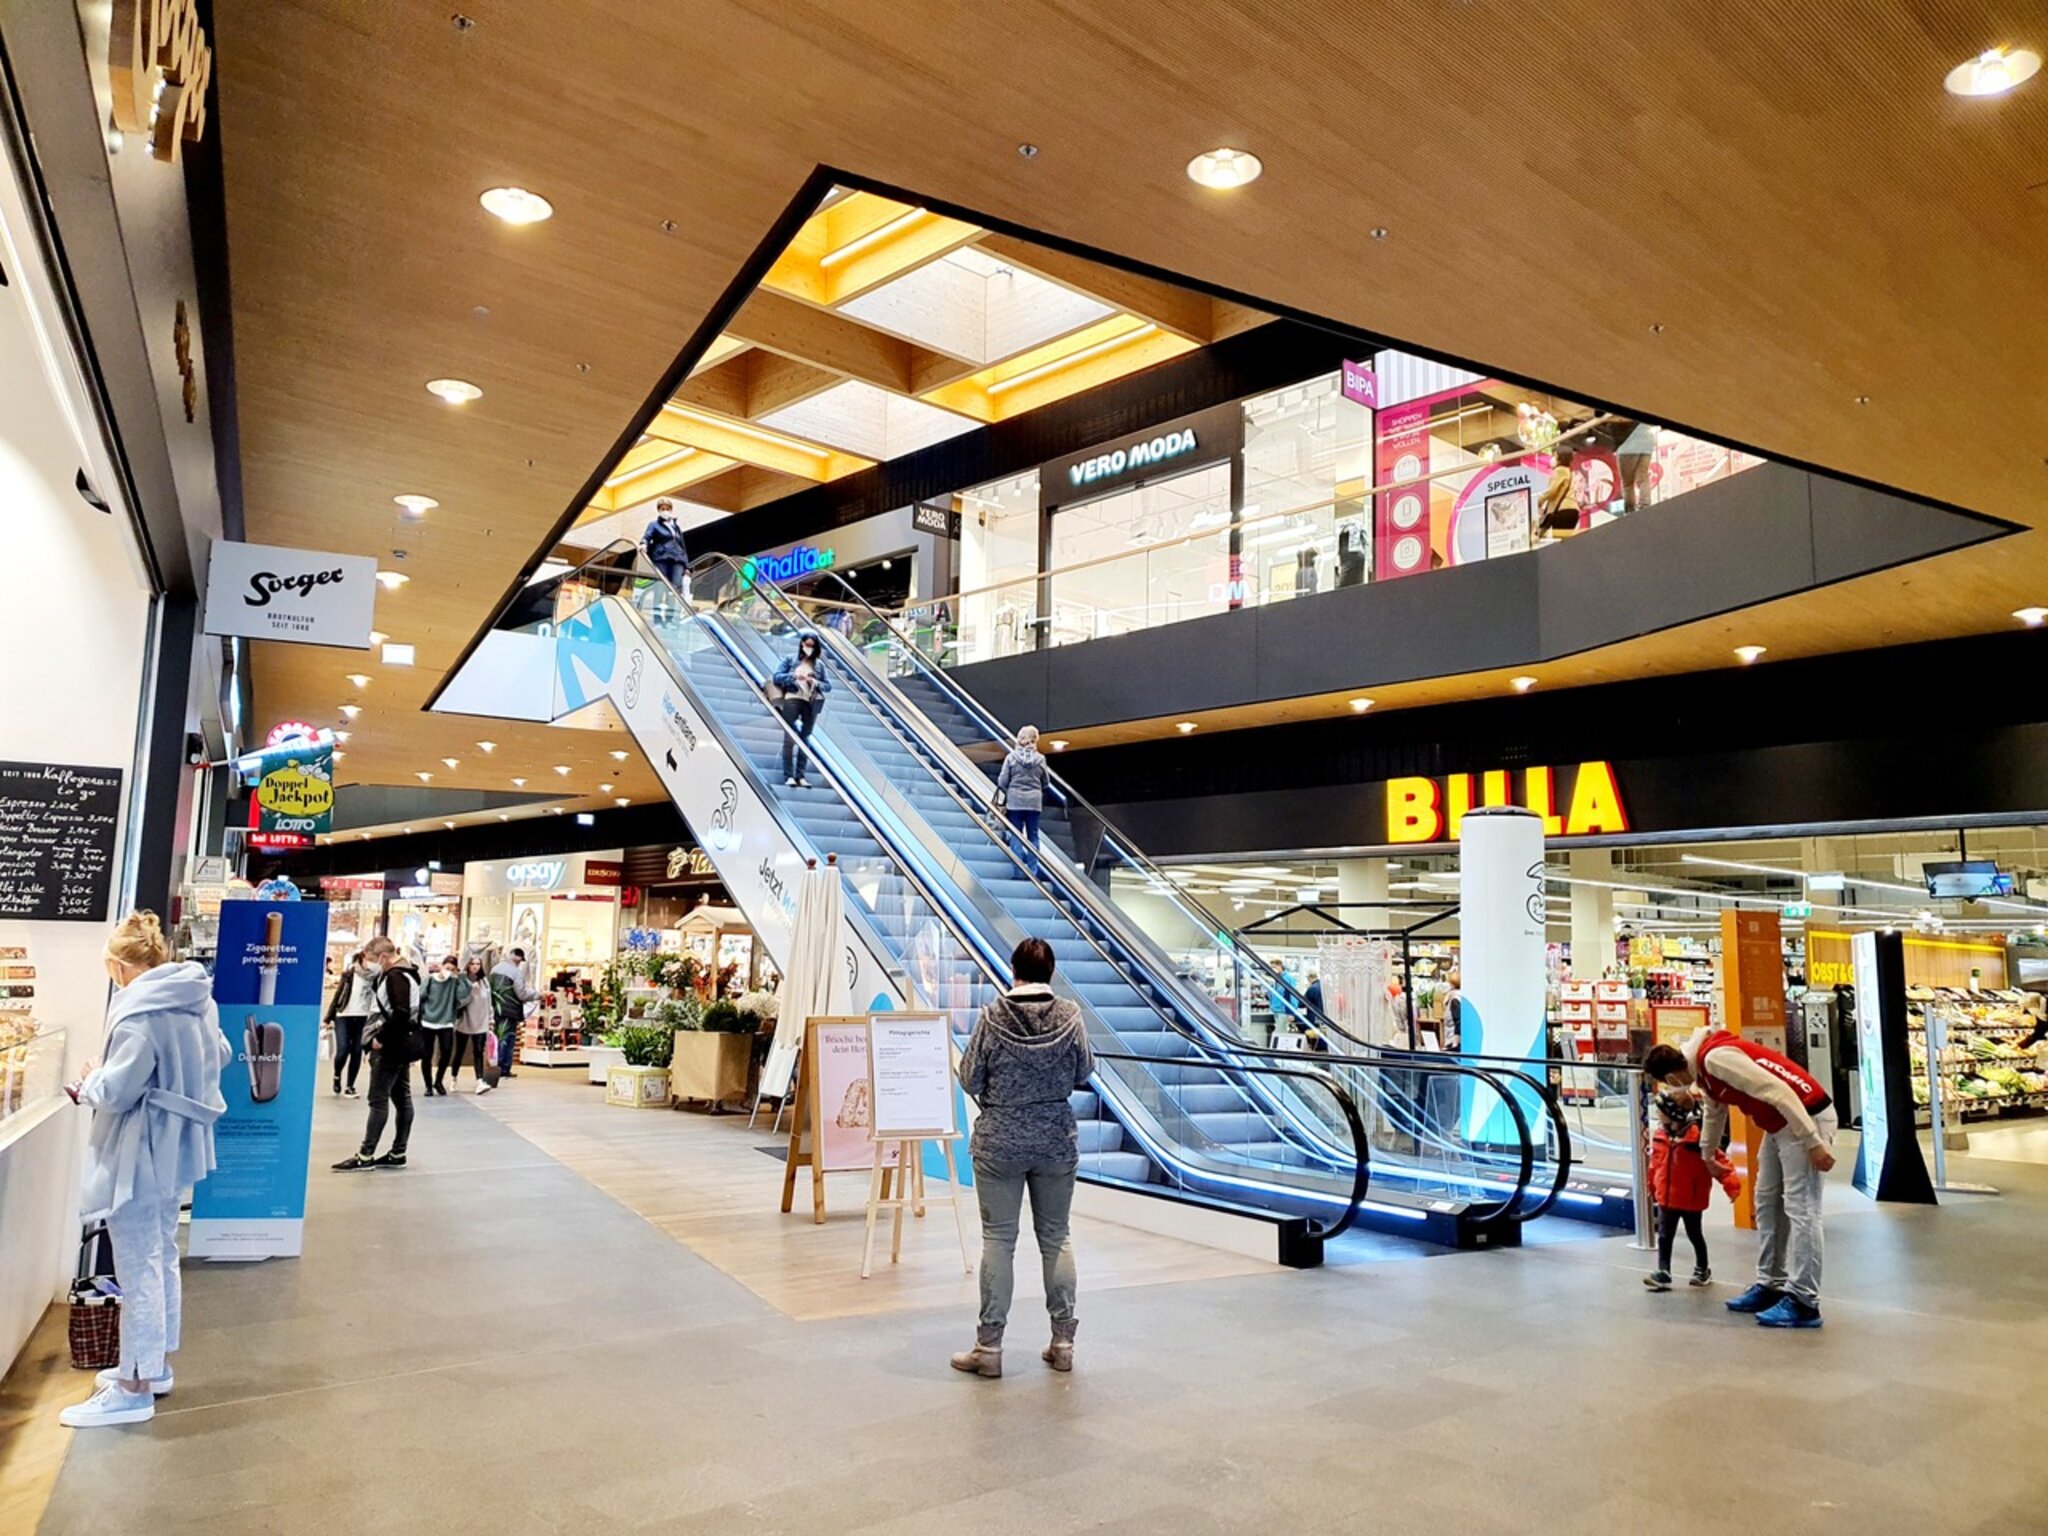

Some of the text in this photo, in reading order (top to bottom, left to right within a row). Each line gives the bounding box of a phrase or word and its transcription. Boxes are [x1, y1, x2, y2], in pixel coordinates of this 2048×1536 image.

[1346, 370, 1375, 399] BIPA
[1070, 428, 1197, 486] VERO MODA
[1487, 474, 1532, 492] SPECIAL
[918, 506, 945, 521] VERO
[917, 515, 947, 530] MODA
[243, 568, 344, 606] Sorger
[272, 621, 288, 629] SEIT
[265, 777, 308, 790] Doppel
[57, 785, 96, 801] to go
[269, 788, 329, 807] Jackpot
[275, 819, 316, 831] LOTTO
[506, 861, 565, 889] orsay
[245, 943, 297, 954] Zigaretten
[242, 954, 298, 965] produzieren
[1813, 962, 1839, 982] OBST
[832, 1046, 849, 1054] dein
[1755, 1057, 1813, 1093] ATOMIC
